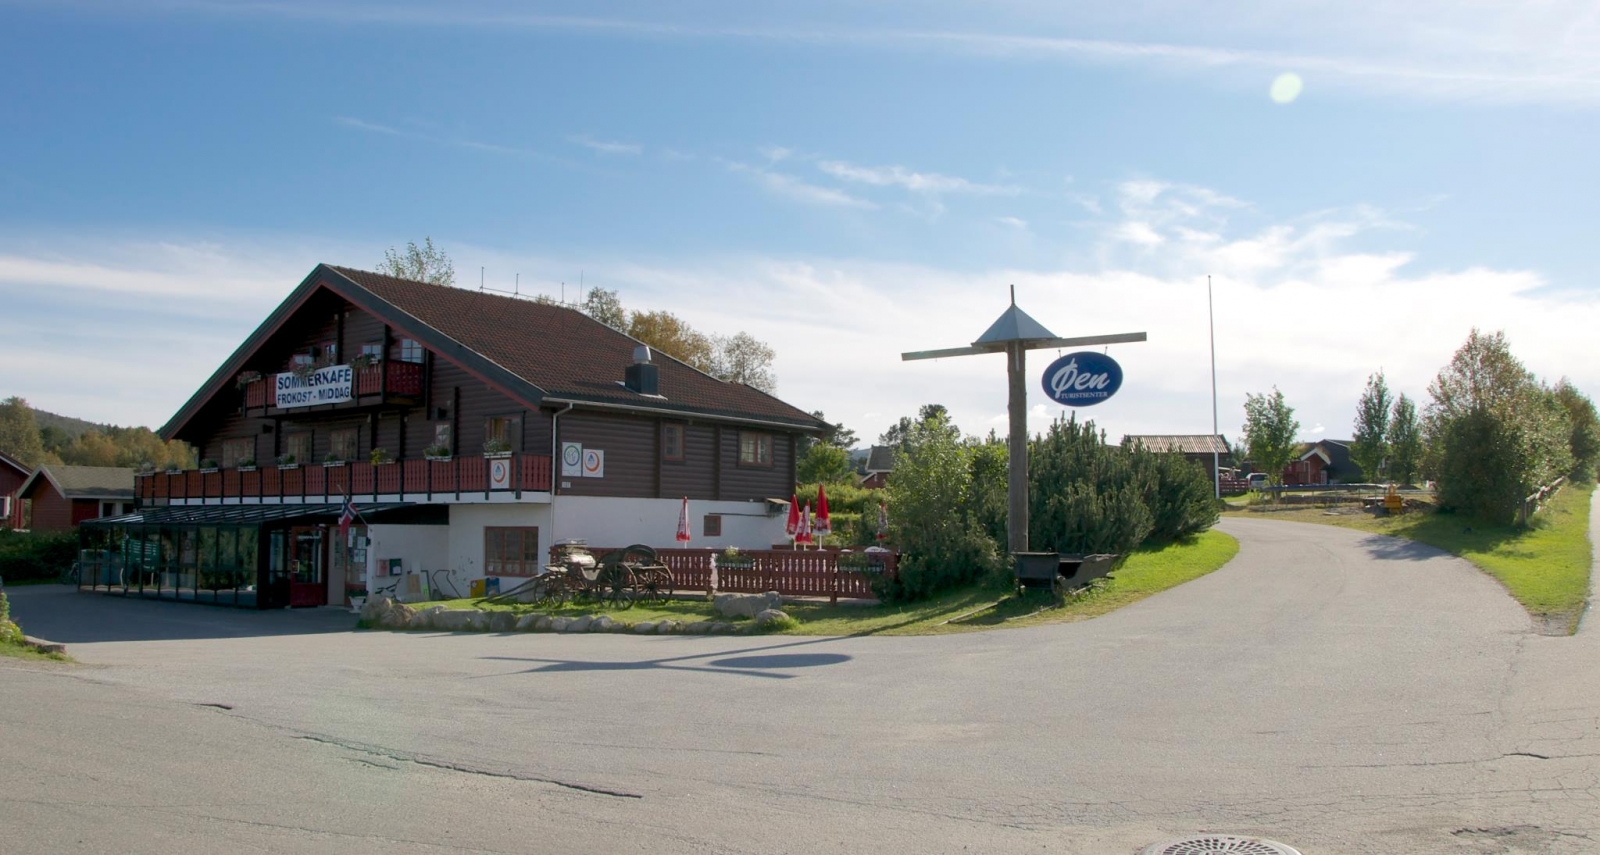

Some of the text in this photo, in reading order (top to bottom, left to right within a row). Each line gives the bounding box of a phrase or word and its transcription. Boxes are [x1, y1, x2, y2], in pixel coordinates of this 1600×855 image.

[277, 391, 313, 404] FROKOST
[318, 386, 350, 400] MIDDAG
[1061, 391, 1108, 399] TURISTSENTER
